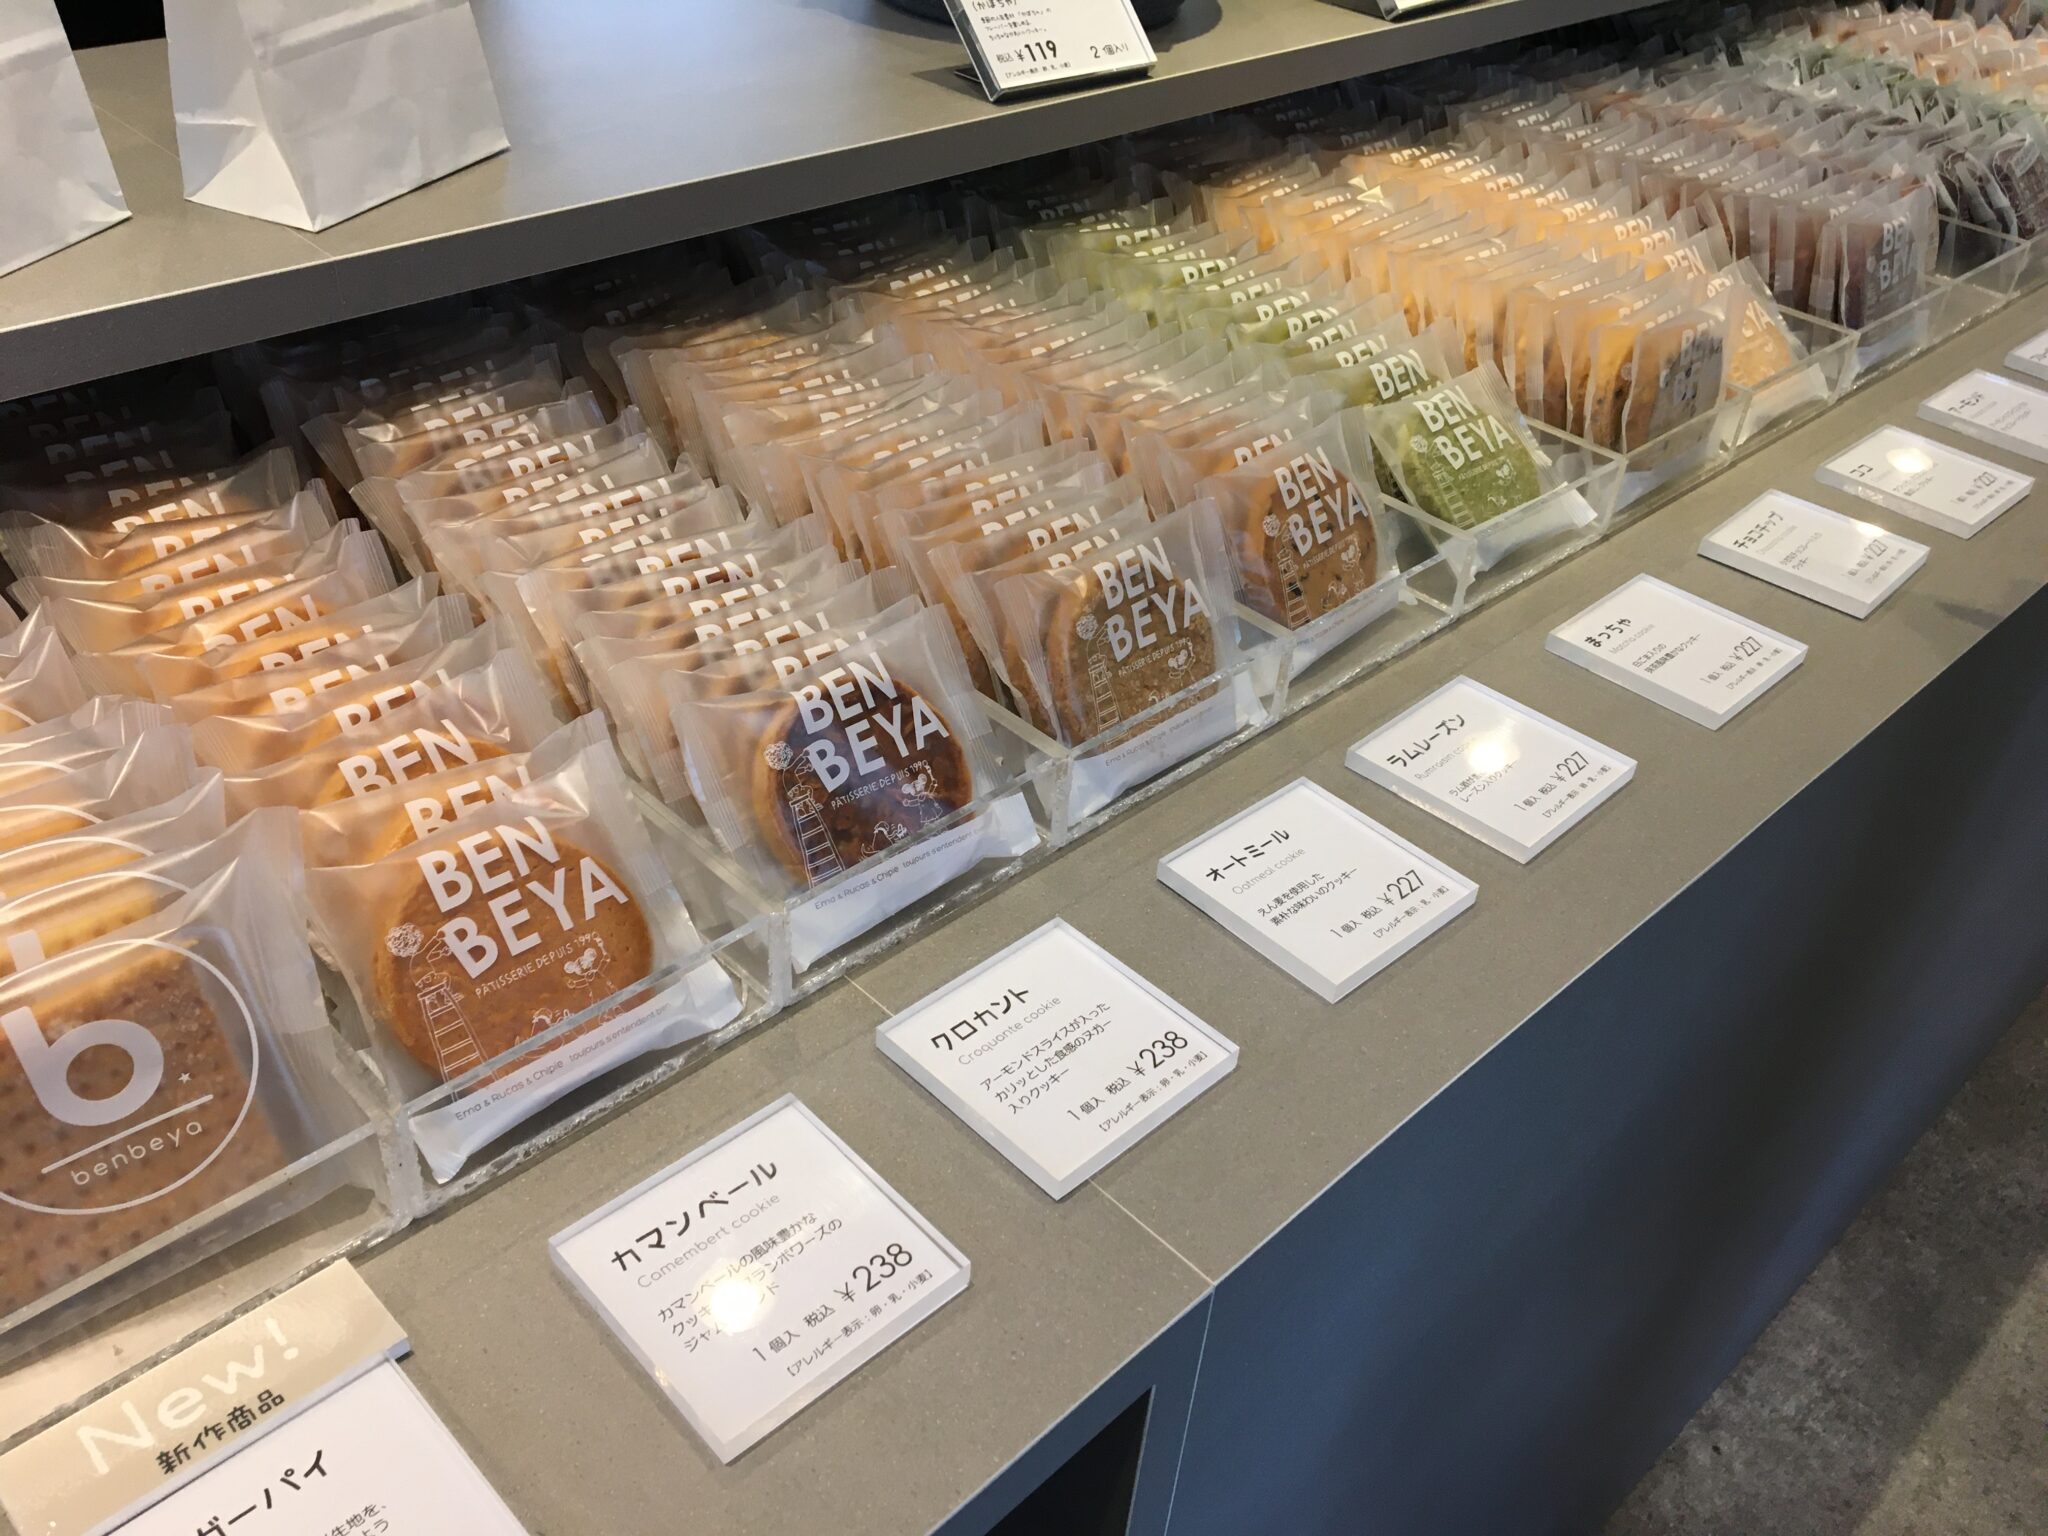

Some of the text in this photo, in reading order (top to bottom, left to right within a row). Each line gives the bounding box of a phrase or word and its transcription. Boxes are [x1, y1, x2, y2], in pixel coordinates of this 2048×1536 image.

[1369, 349, 1429, 400] BEN
[1413, 385, 1478, 433] BEN
[1435, 415, 1516, 470] BEYA
[1849, 463, 1874, 478] ココ
[1274, 446, 1338, 510] BEN
[1289, 482, 1369, 557] BEYA
[1732, 510, 1784, 549] チョコチップ
[1092, 537, 1174, 610] BEN
[1105, 578, 1211, 663] BEYA
[1584, 618, 1632, 648] まっちゃ
[790, 652, 898, 735] BEN
[338, 719, 480, 799] BEN
[806, 695, 950, 794] BEYA
[1386, 714, 1465, 767] ラムレーズン
[879, 769, 909, 789] DEPUIS
[416, 816, 561, 913] BEN
[843, 880, 870, 897] Rucas
[876, 864, 899, 882] Chipie
[1205, 829, 1290, 882] オートミール
[1232, 848, 1307, 895] Oatmeal cookie
[441, 856, 629, 980] BEYA
[1257, 872, 1325, 917] えん麦を使用した
[1269, 867, 1358, 926] 素朴な味わいのクッキー
[475, 963, 536, 999] PÂTISSERIE
[535, 944, 574, 970] DEPUIS
[930, 988, 1029, 1051] クロカント
[958, 996, 1062, 1066] Croquante cookie
[979, 1002, 1111, 1092] アーモンドスライスが入った
[490, 1081, 525, 1103] Rucas
[532, 1058, 564, 1081] Chipie
[568, 1038, 606, 1063] toujours
[994, 1020, 1112, 1103] カリッとした食感のヌガー
[1008, 1068, 1070, 1115] 入りクッキー
[1105, 1076, 1132, 1096] 税込
[1126, 1031, 1188, 1077] ¥238
[70, 1121, 203, 1185] benbeya
[611, 1162, 778, 1272] カマンベール
[637, 1193, 781, 1289] Camembert cookie
[657, 1212, 818, 1323] カマンベールの風味豊かな
[802, 1304, 836, 1329] 税込
[833, 1243, 913, 1304] ¥238
[75, 1317, 299, 1476] New!
[155, 1388, 286, 1476] 新作商品
